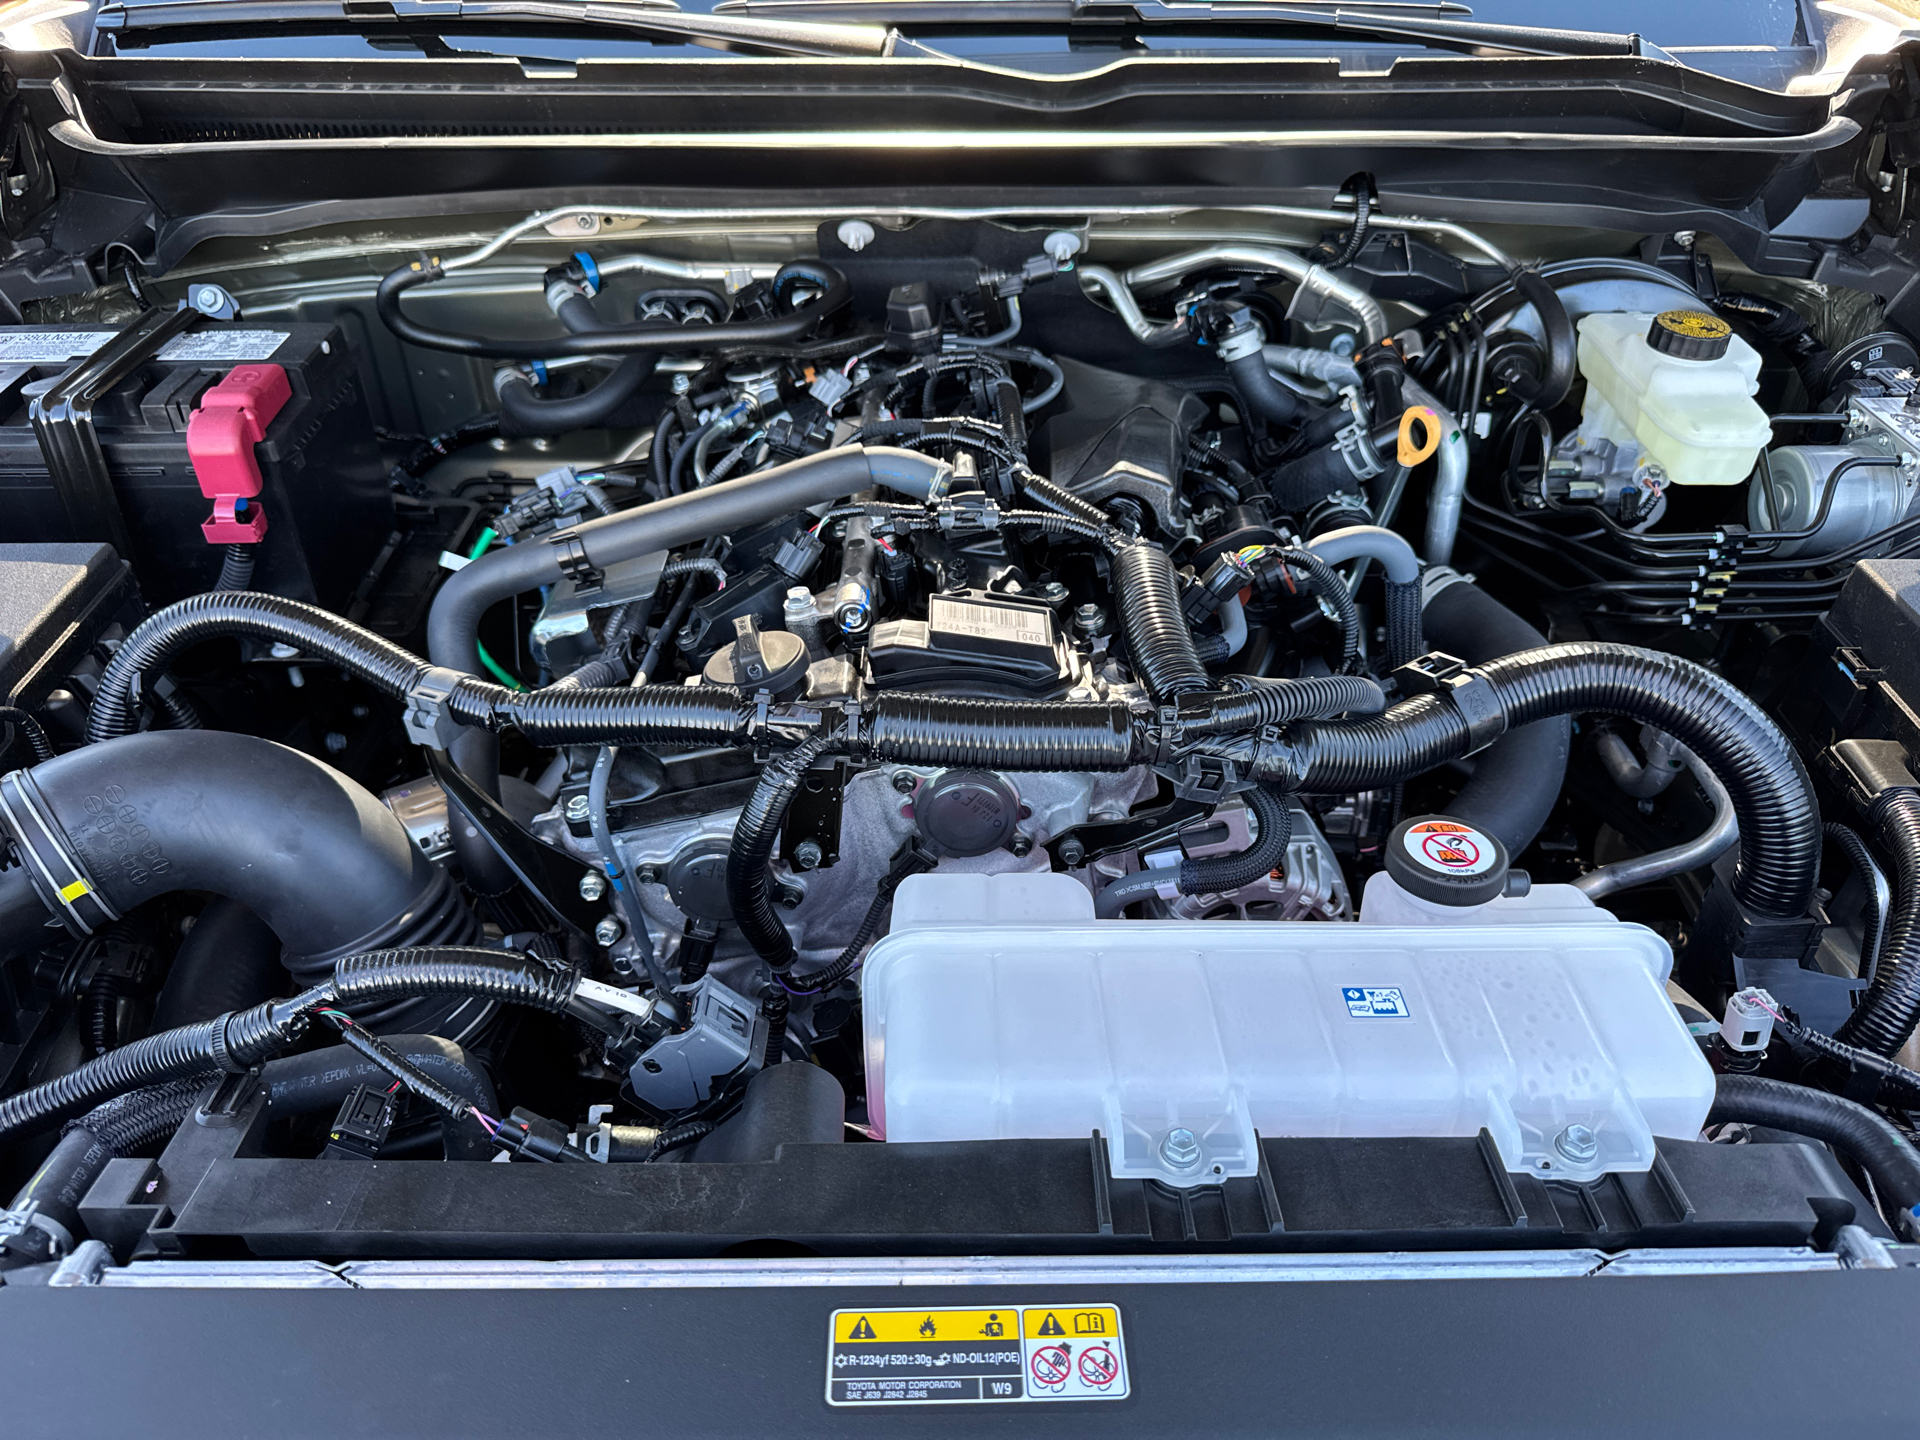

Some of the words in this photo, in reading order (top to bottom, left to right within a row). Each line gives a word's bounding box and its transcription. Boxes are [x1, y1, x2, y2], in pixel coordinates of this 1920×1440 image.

[1022, 633, 1041, 643] 040
[849, 1354, 890, 1368] R-1234yf
[890, 1354, 932, 1367] 520±30g
[952, 1351, 1021, 1366] ND-OIL12(POE)
[846, 1382, 876, 1391] TOYOTA
[878, 1381, 906, 1390] MOTOR
[908, 1380, 962, 1389] CORPORATION
[991, 1382, 1013, 1395] W9
[846, 1391, 862, 1399] SAE
[863, 1390, 881, 1399] J639
